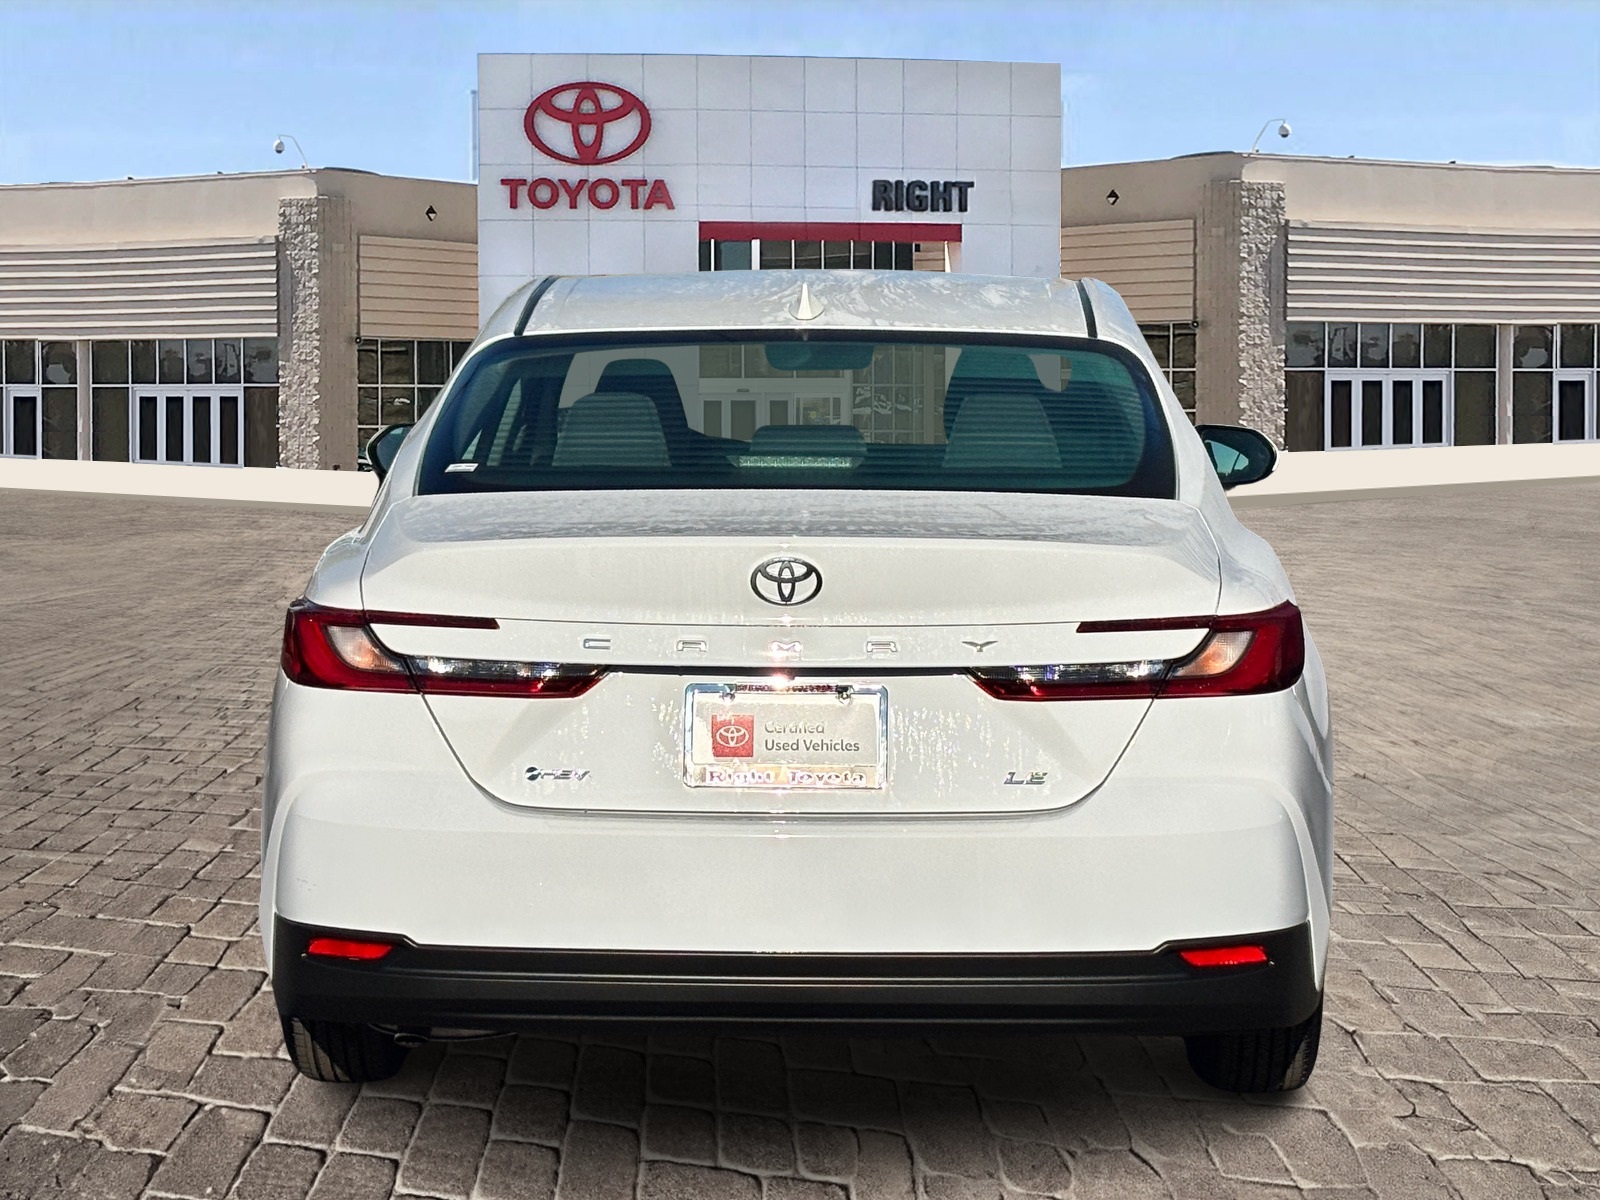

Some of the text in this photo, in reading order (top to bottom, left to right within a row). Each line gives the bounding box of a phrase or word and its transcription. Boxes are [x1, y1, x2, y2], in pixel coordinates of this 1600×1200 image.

[500, 178, 675, 209] TOYOTA
[872, 179, 975, 212] RIGHT
[583, 637, 998, 653] CAMRY
[764, 721, 825, 734] Certified
[765, 739, 860, 751] Used Vehicles
[787, 769, 867, 787] Toyota
[1003, 771, 1048, 785] LE
